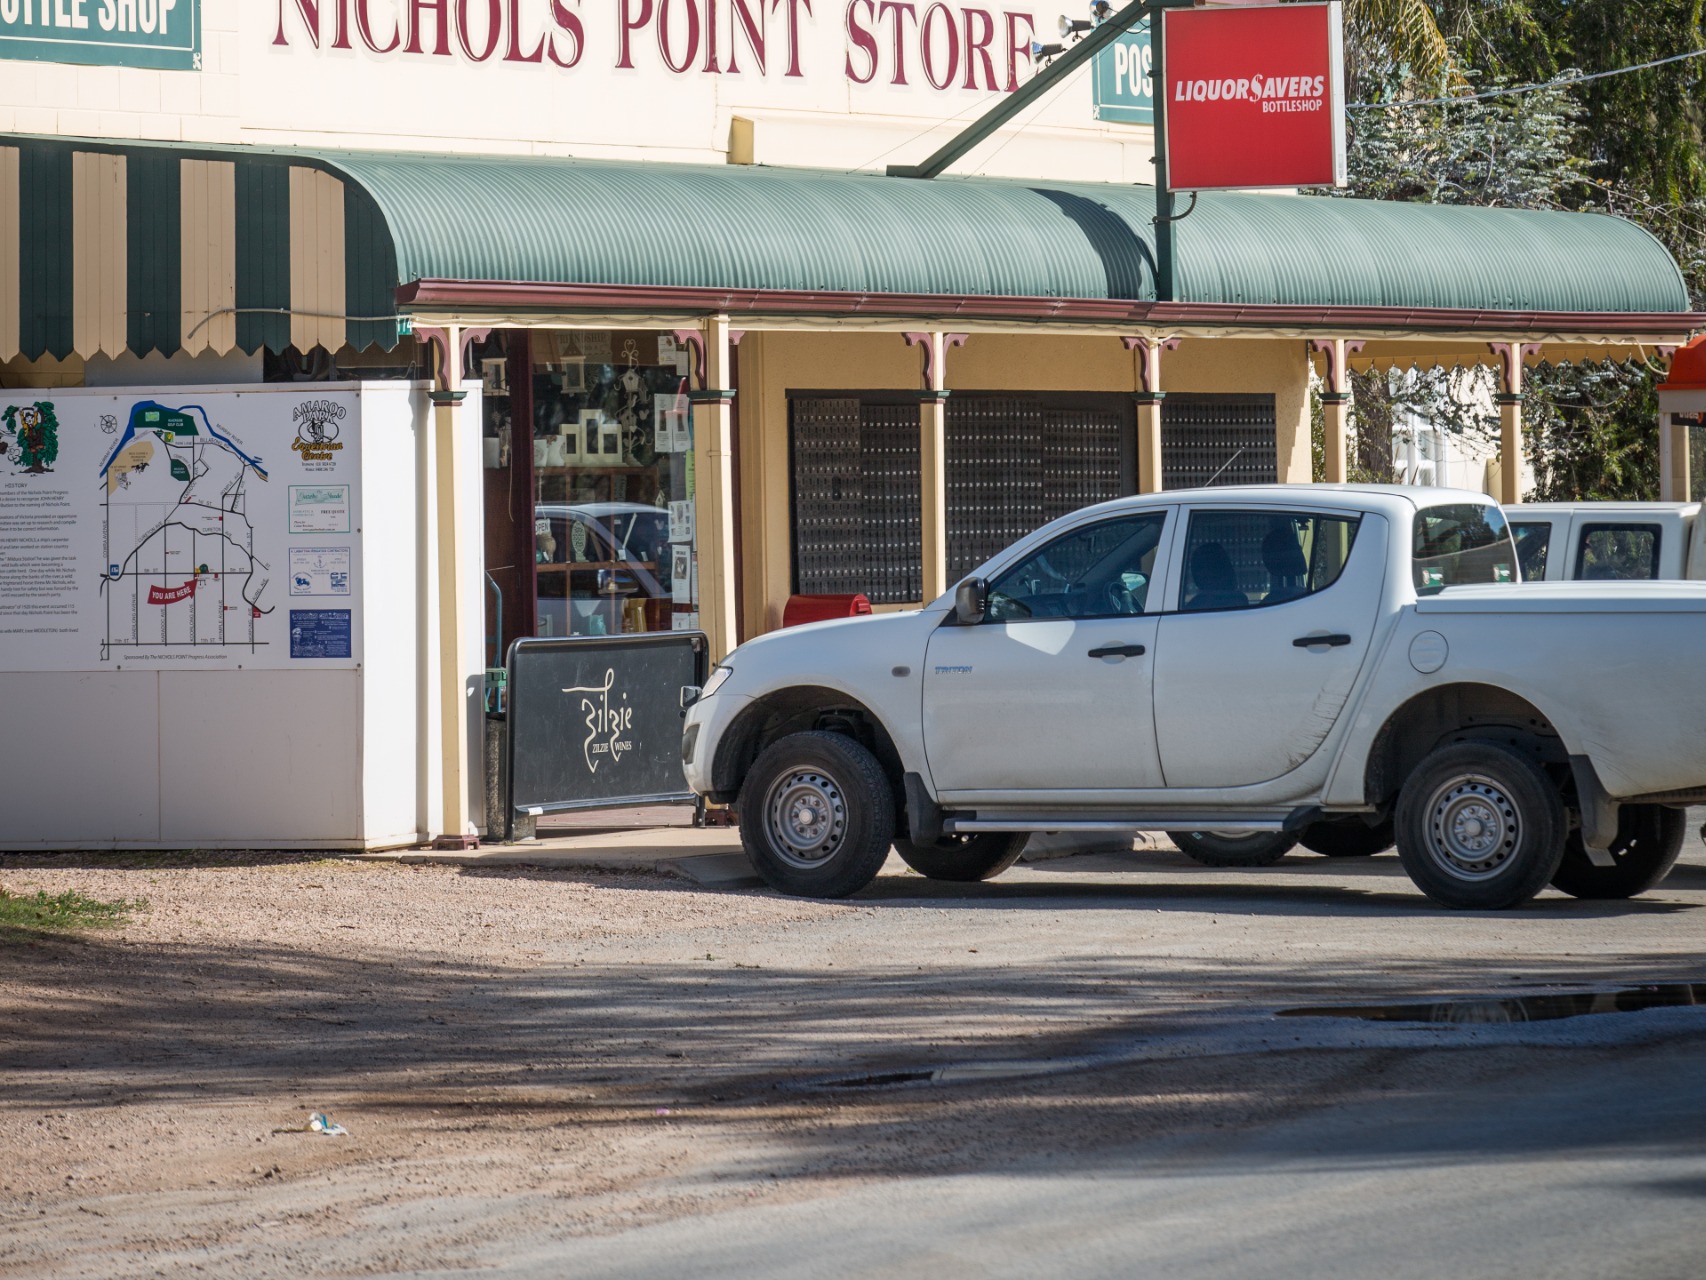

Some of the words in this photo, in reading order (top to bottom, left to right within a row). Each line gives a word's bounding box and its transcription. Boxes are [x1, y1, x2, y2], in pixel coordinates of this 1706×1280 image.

[1114, 42, 1153, 97] POS
[1262, 99, 1323, 113] BOTTLESHOP
[293, 400, 347, 422] AMAROO
[302, 410, 337, 424] PARK
[231, 435, 244, 445] RIVER
[152, 591, 164, 599] YOU
[164, 591, 176, 599] ARE
[176, 586, 192, 598] HERE
[592, 742, 609, 753] ZILZIE
[614, 740, 632, 752] WINES
